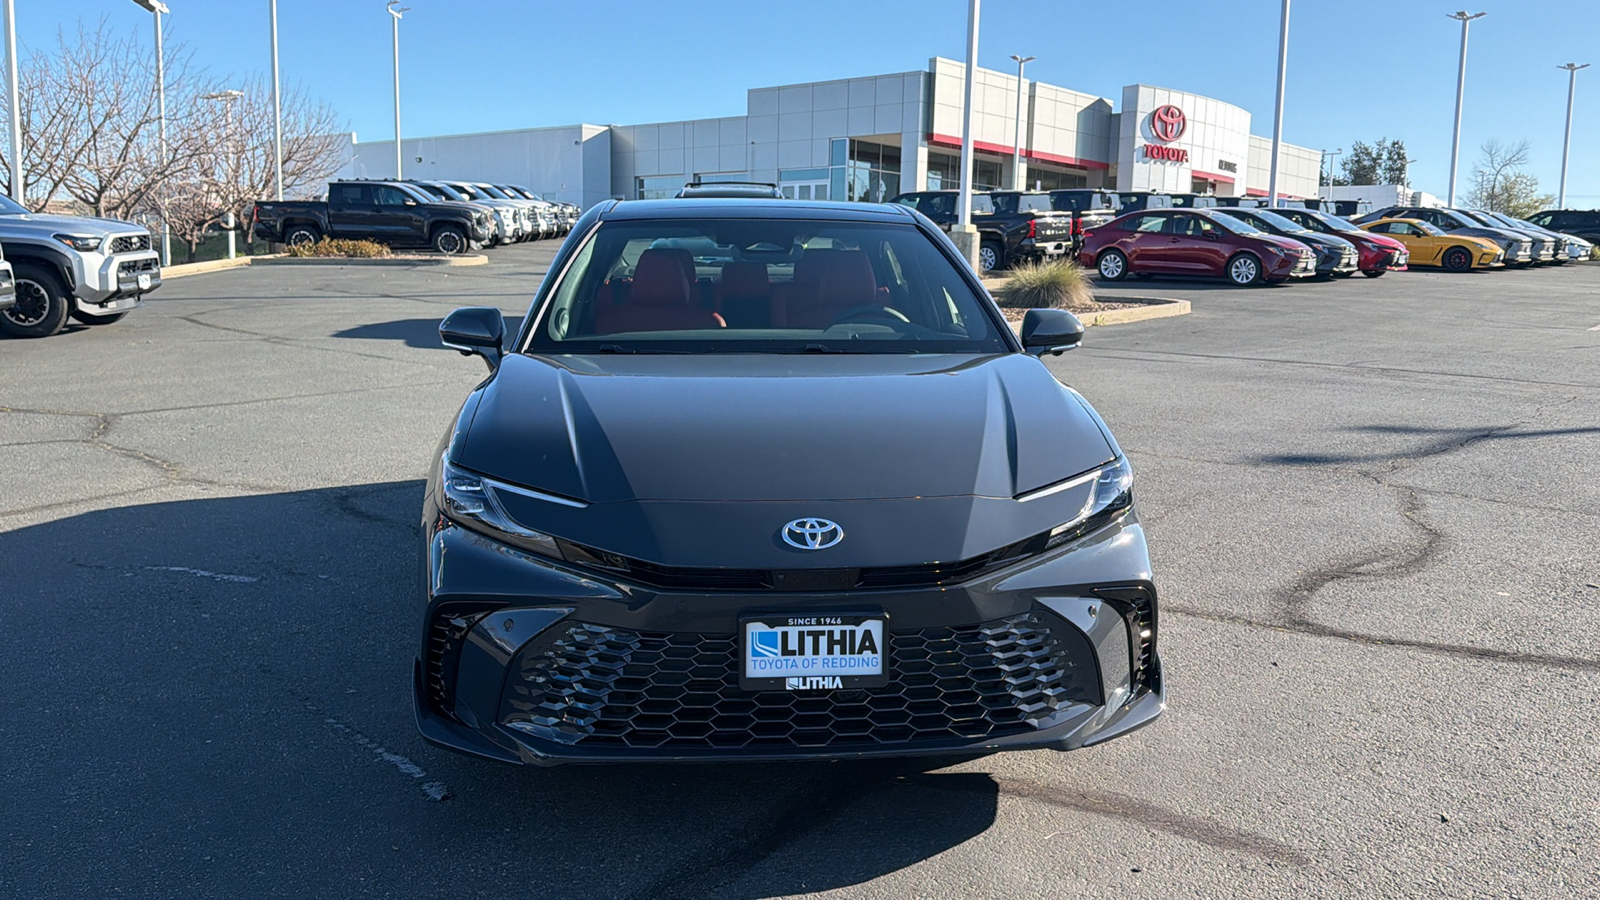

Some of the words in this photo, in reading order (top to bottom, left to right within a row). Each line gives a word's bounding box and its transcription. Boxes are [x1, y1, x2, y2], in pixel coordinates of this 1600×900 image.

[1144, 144, 1188, 162] TOYOTA
[788, 618, 817, 626] SINCE
[820, 617, 842, 625] 1946
[781, 629, 878, 657] LITHIA
[751, 658, 798, 670] TOYOTA
[802, 657, 818, 669] OF
[822, 656, 879, 669] REDDING
[798, 676, 843, 690] LITHIA
